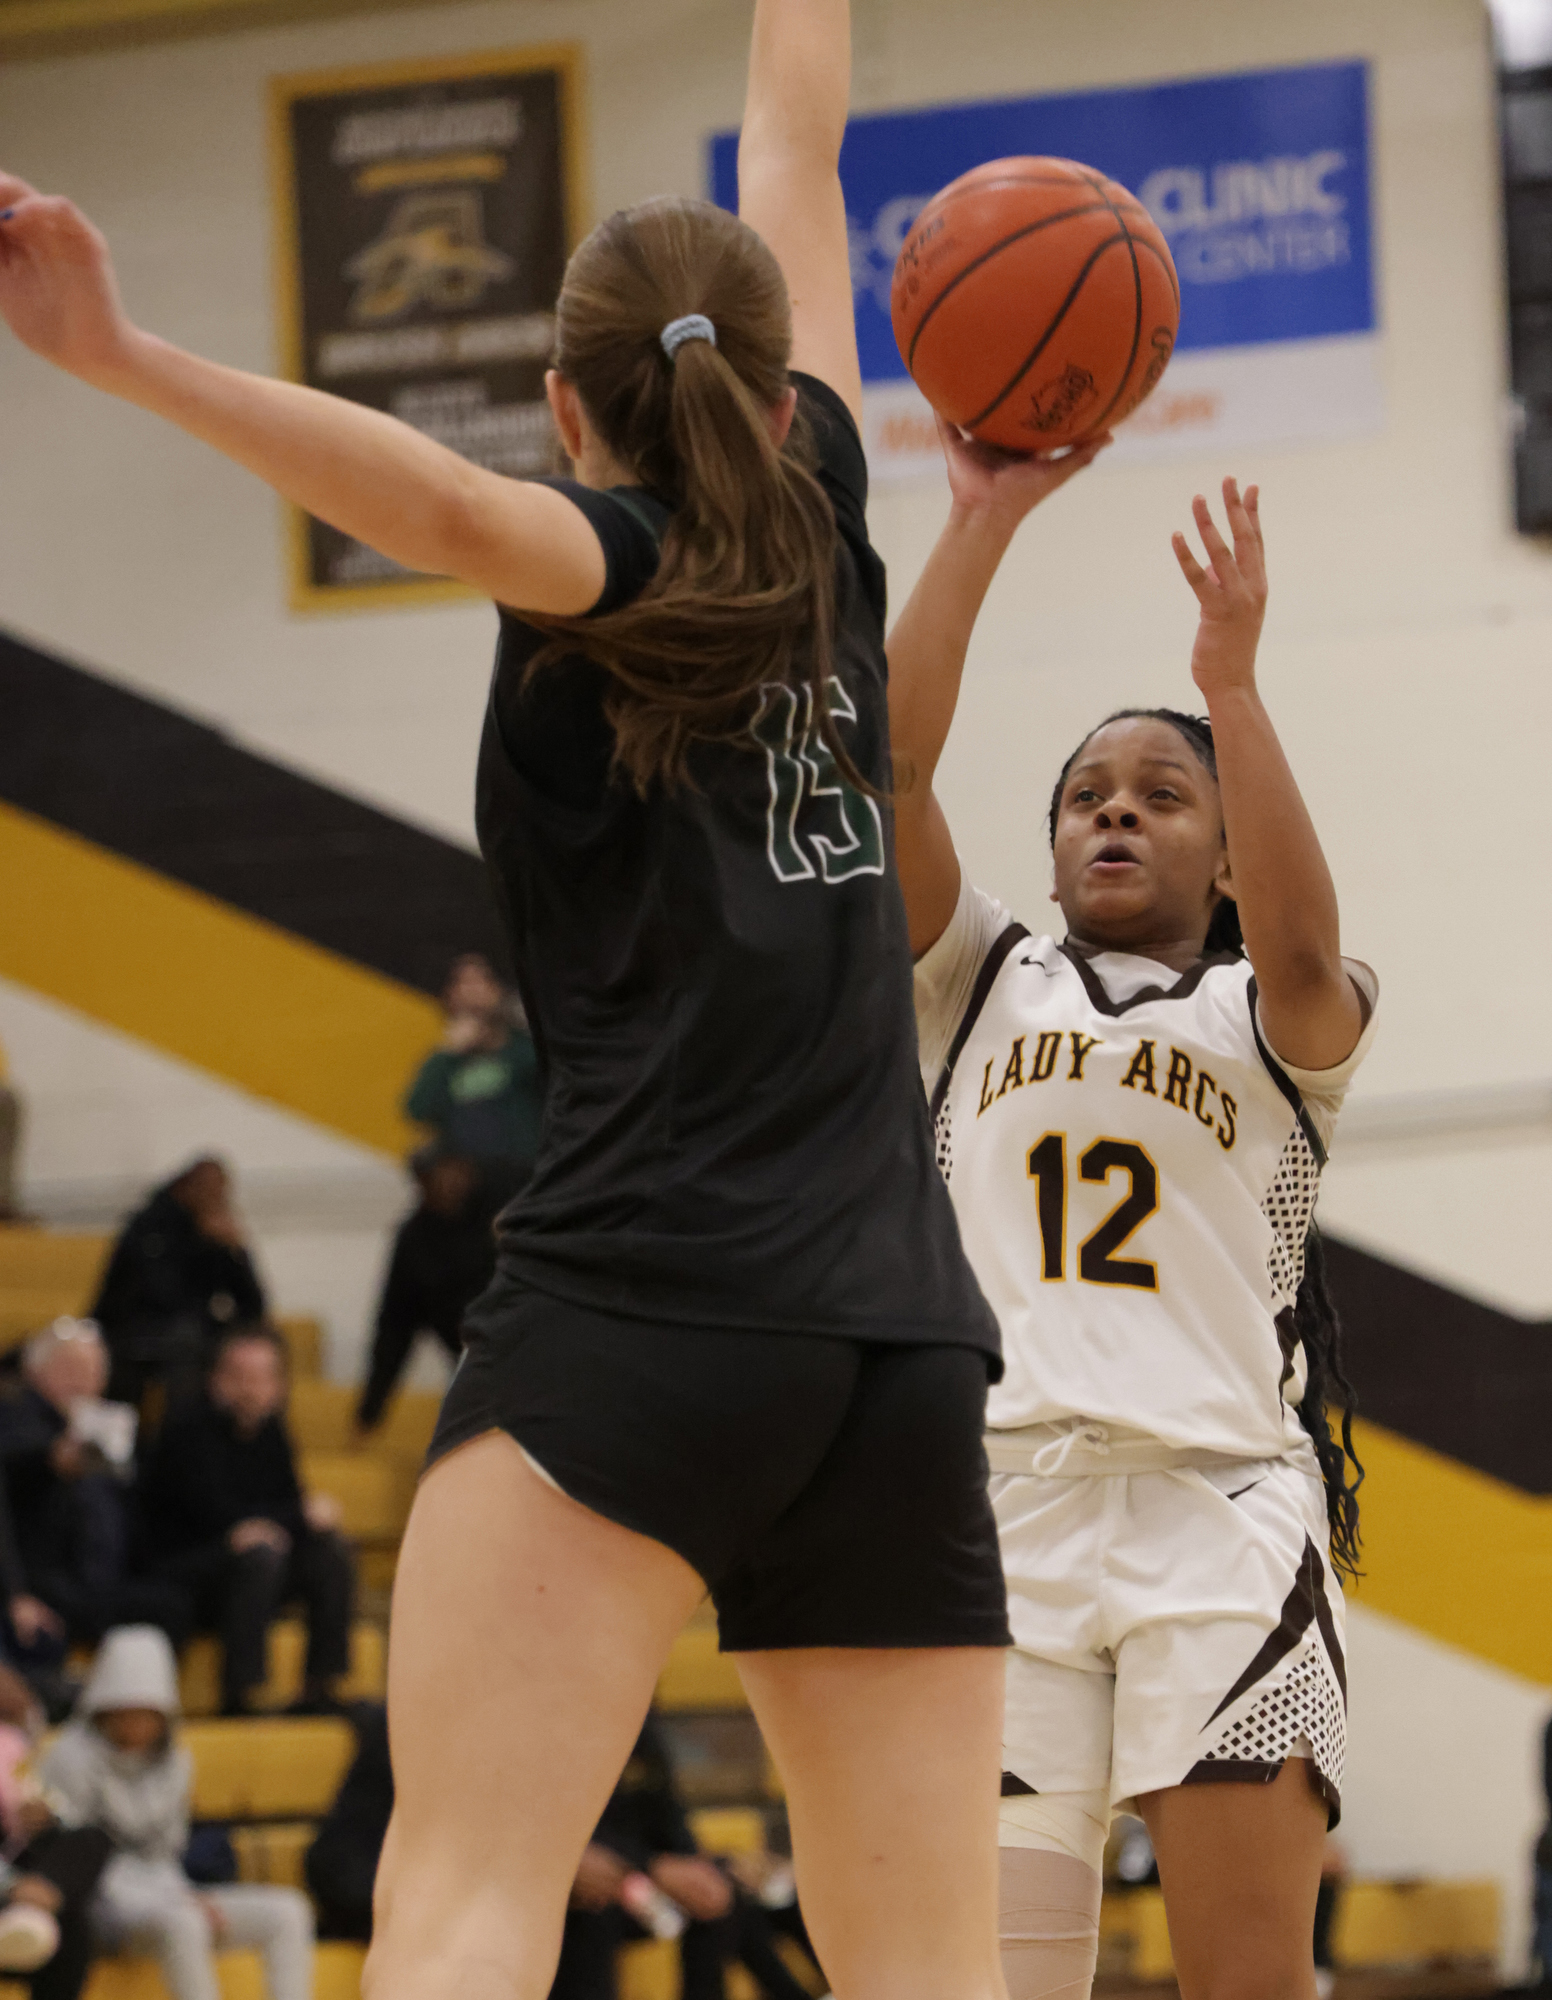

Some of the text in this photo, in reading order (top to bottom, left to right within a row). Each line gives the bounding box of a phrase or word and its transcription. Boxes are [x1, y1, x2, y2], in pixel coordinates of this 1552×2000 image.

[751, 674, 885, 884] 15
[976, 1031, 1238, 1151] LADY ARCS
[1026, 1130, 1160, 1294] 12
